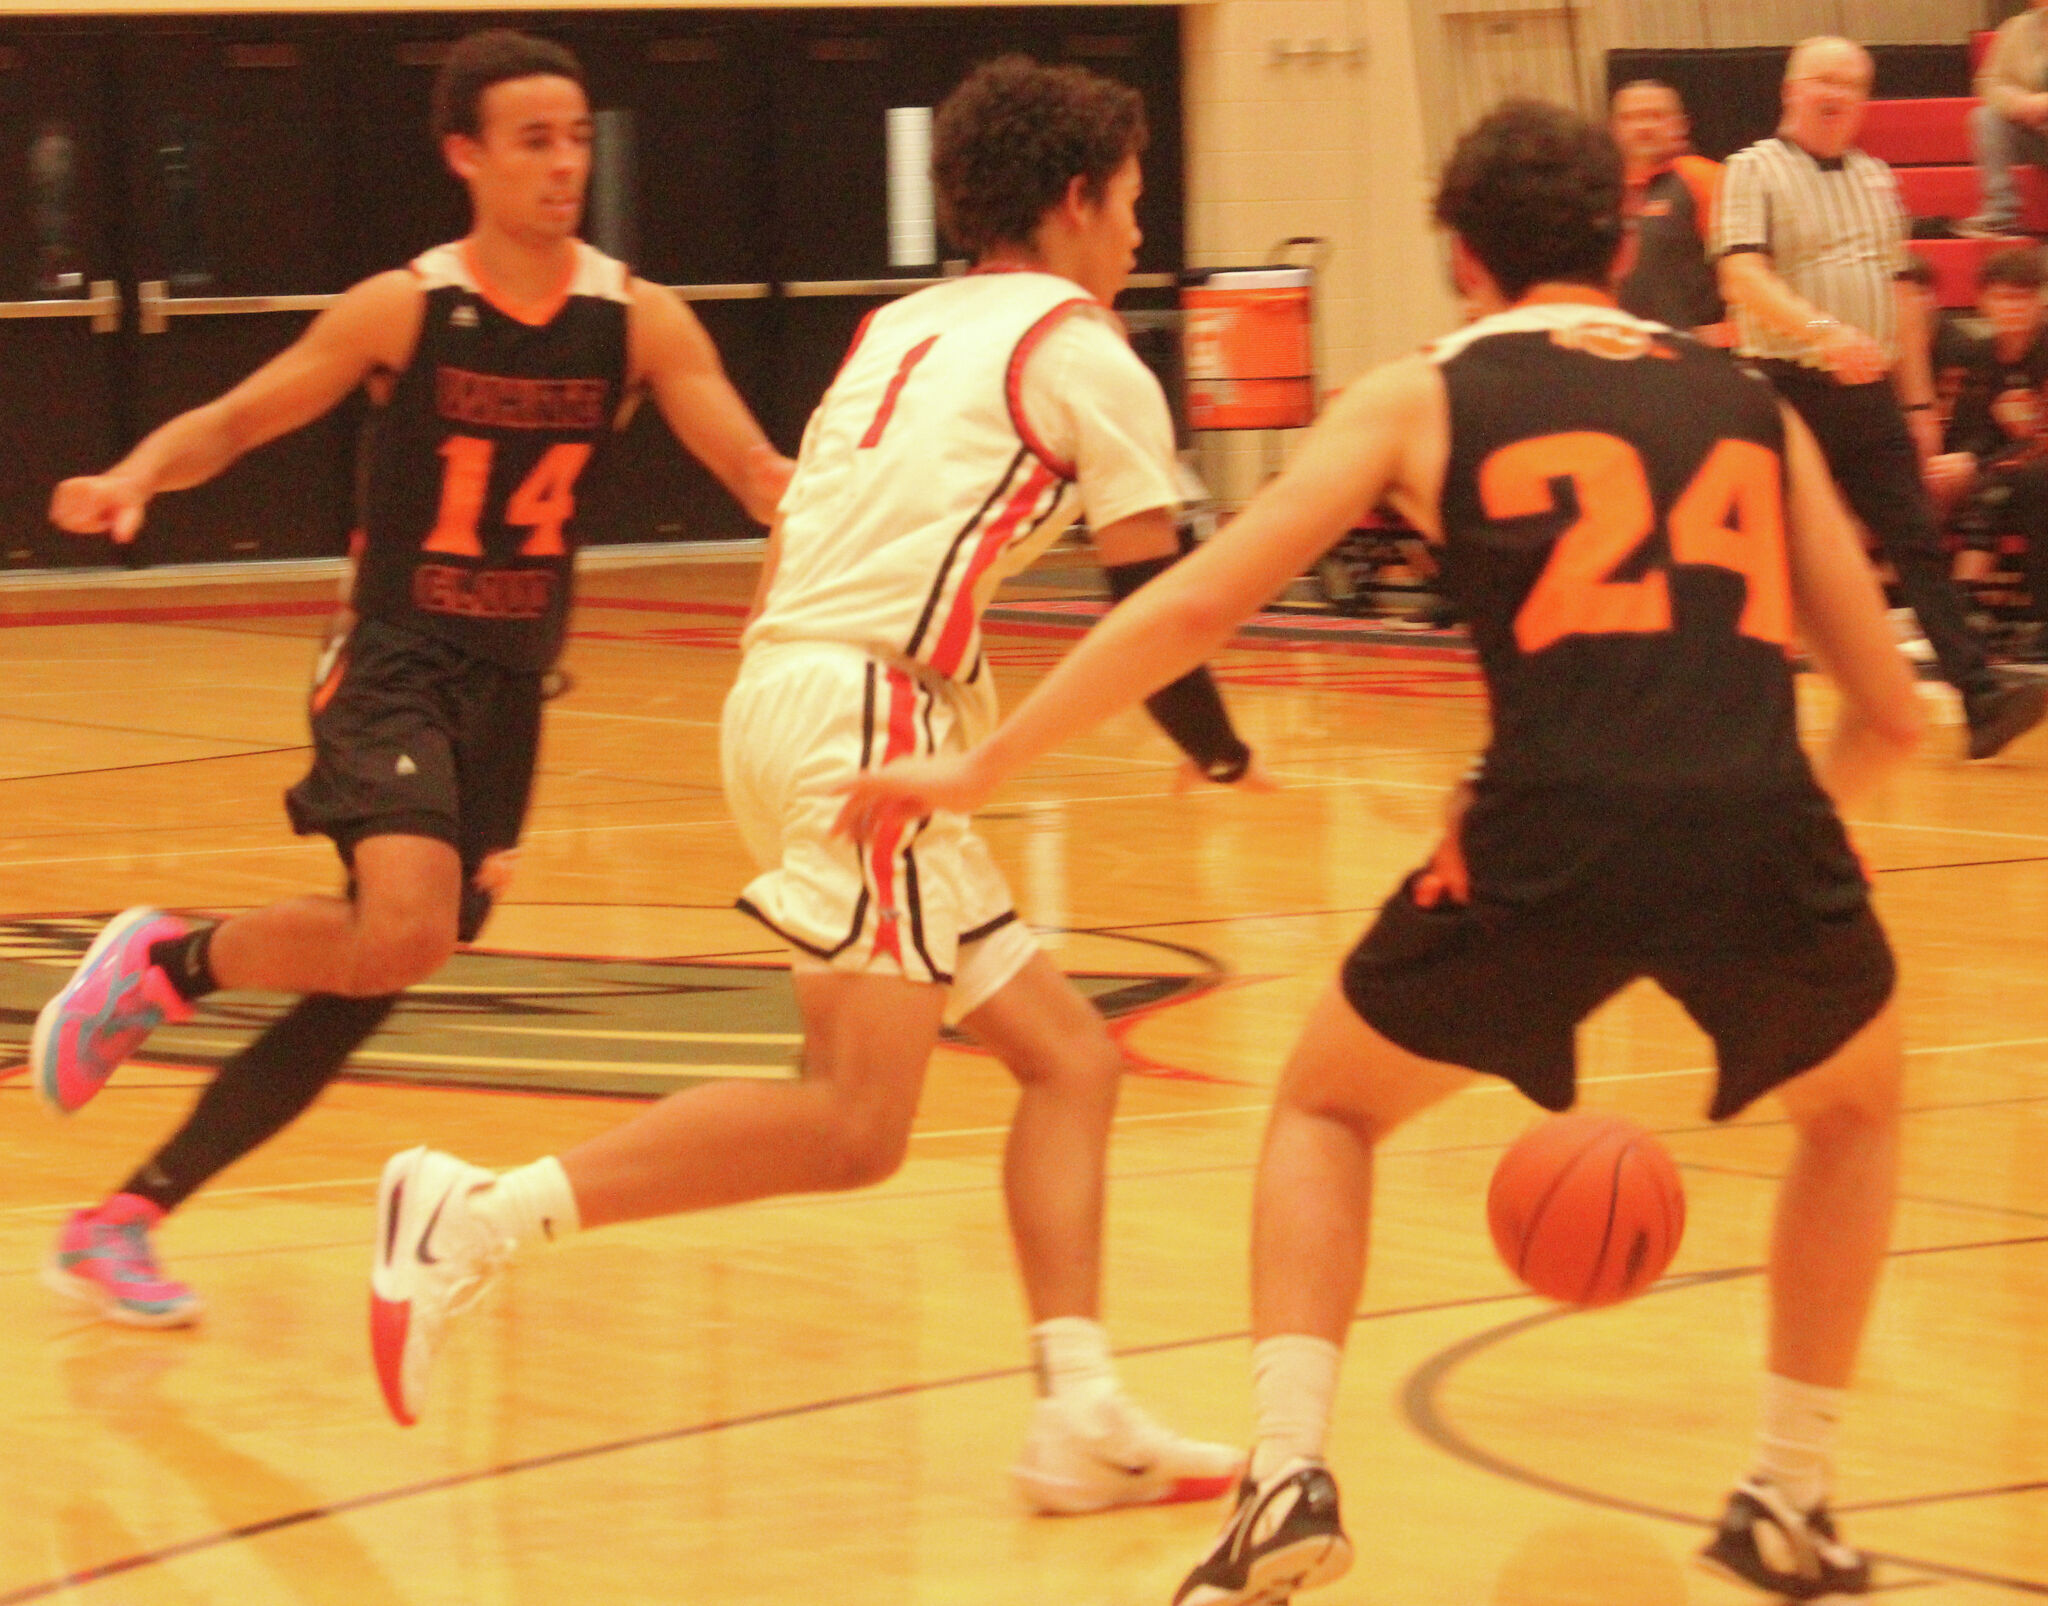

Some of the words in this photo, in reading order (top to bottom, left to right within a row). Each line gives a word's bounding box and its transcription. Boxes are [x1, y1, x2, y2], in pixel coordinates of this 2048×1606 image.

[857, 334, 942, 450] 1
[422, 434, 595, 557] 14
[1479, 431, 1794, 654] 24
